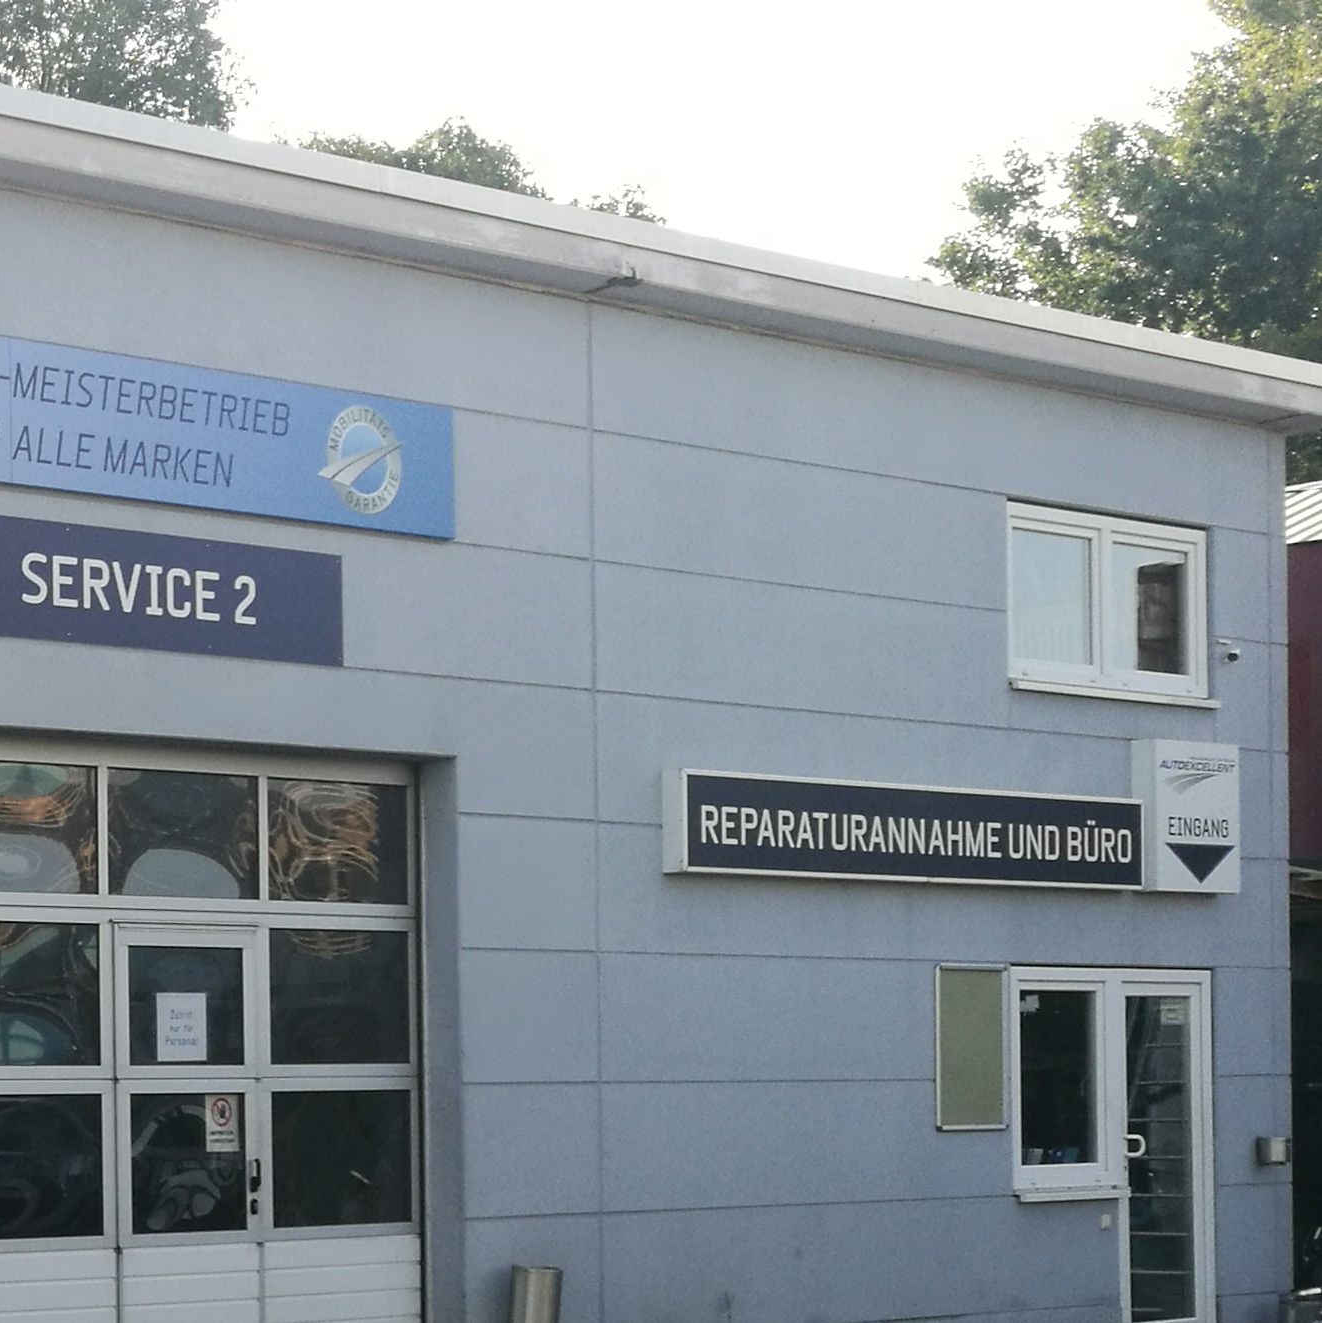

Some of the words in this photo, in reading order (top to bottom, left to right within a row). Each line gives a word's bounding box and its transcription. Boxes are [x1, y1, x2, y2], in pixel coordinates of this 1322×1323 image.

[12, 424, 96, 470] ALLE
[103, 437, 235, 489] MARKEN
[345, 471, 398, 511] GARANTIE
[21, 552, 221, 622] SERVICE
[233, 575, 257, 626] 2
[700, 804, 1003, 859] REPARATURANNAHME
[1008, 824, 1061, 862] UND
[1067, 819, 1133, 864] BÜRO
[1168, 816, 1229, 838] EINGANG
